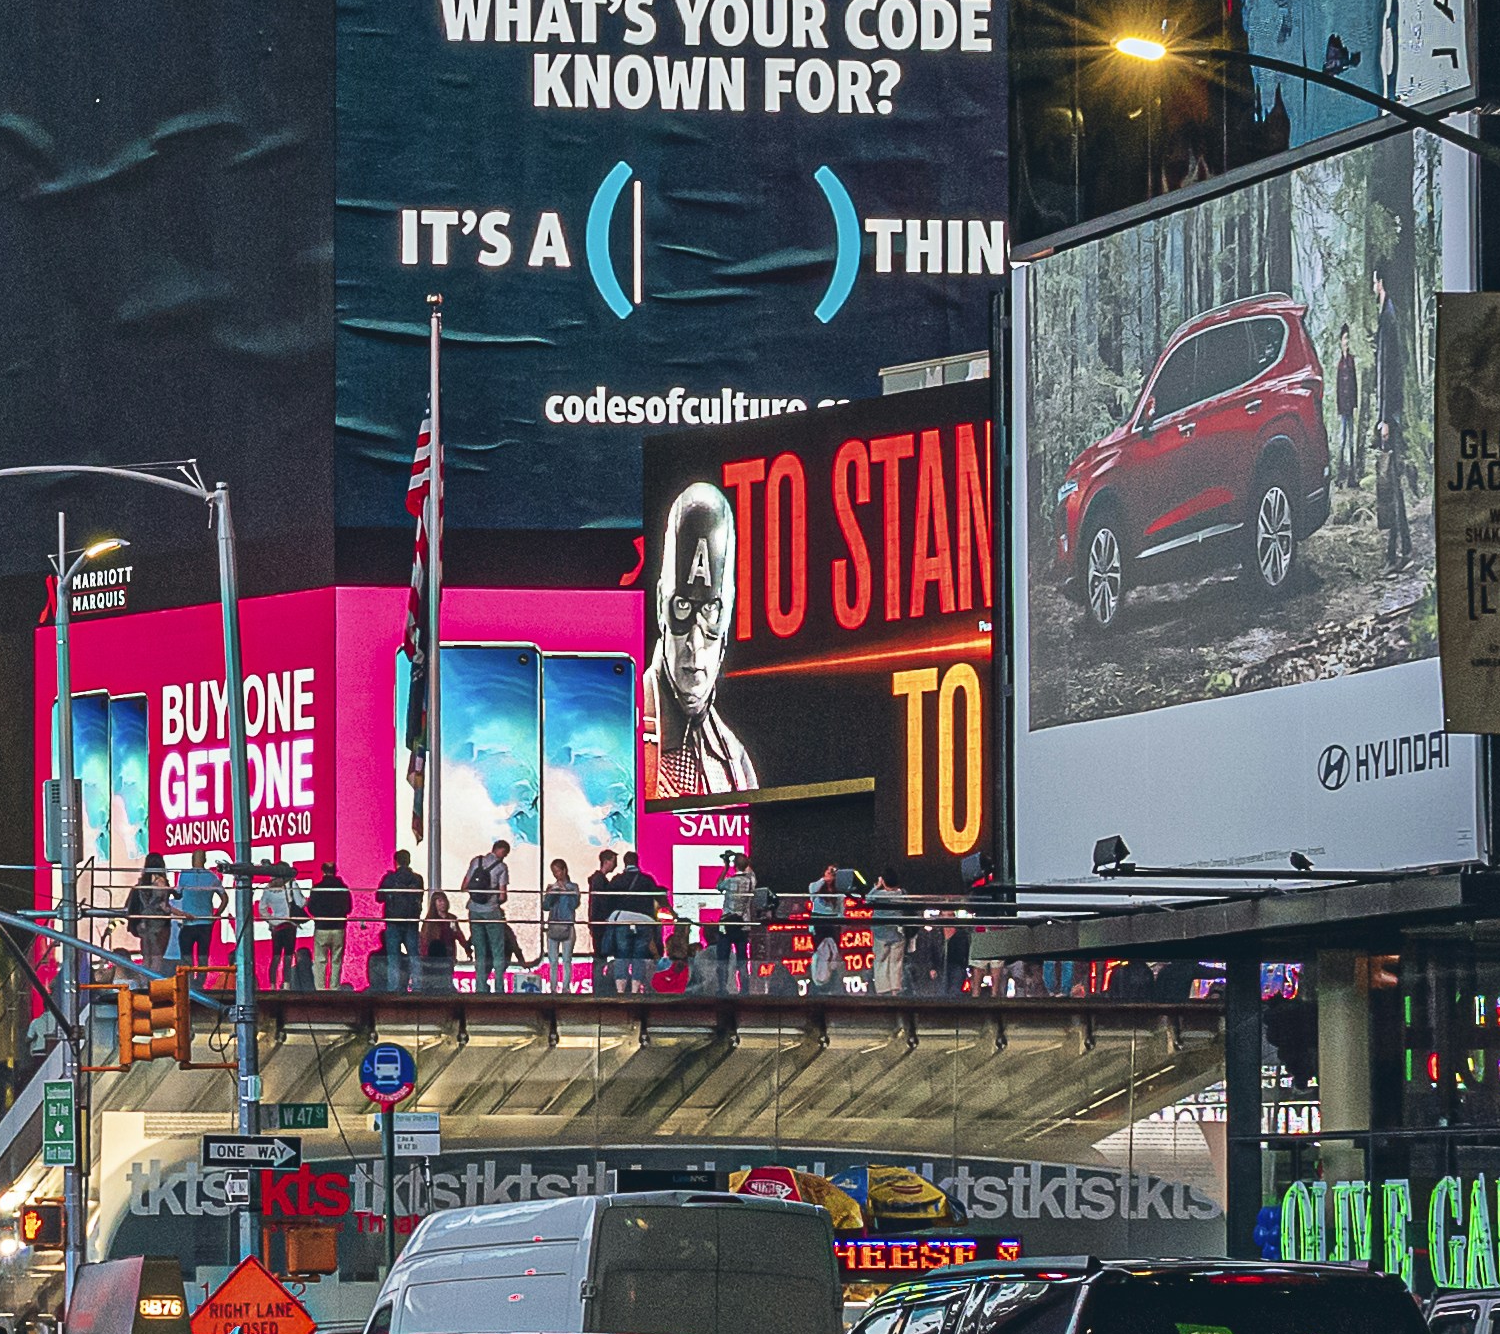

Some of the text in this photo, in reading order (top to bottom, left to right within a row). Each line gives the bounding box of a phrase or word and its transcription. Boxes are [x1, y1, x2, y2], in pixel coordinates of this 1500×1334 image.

[533, 53, 903, 115] KNOWN FOR?
[400, 209, 570, 267] IT'S A
[723, 453, 806, 641] TO
[73, 565, 133, 590] MARRIOTT
[73, 588, 126, 612] MARQUIS
[244, 669, 314, 734] ONE
[160, 739, 314, 819] GET ONE
[893, 662, 982, 857] TO
[1356, 731, 1450, 783] HYUNDAI
[166, 811, 311, 847] SAMSUNG S10
[283, 1107, 313, 1125] W 47
[217, 1144, 287, 1159] ONE WAY
[209, 1301, 294, 1319] RIGHT LANE
